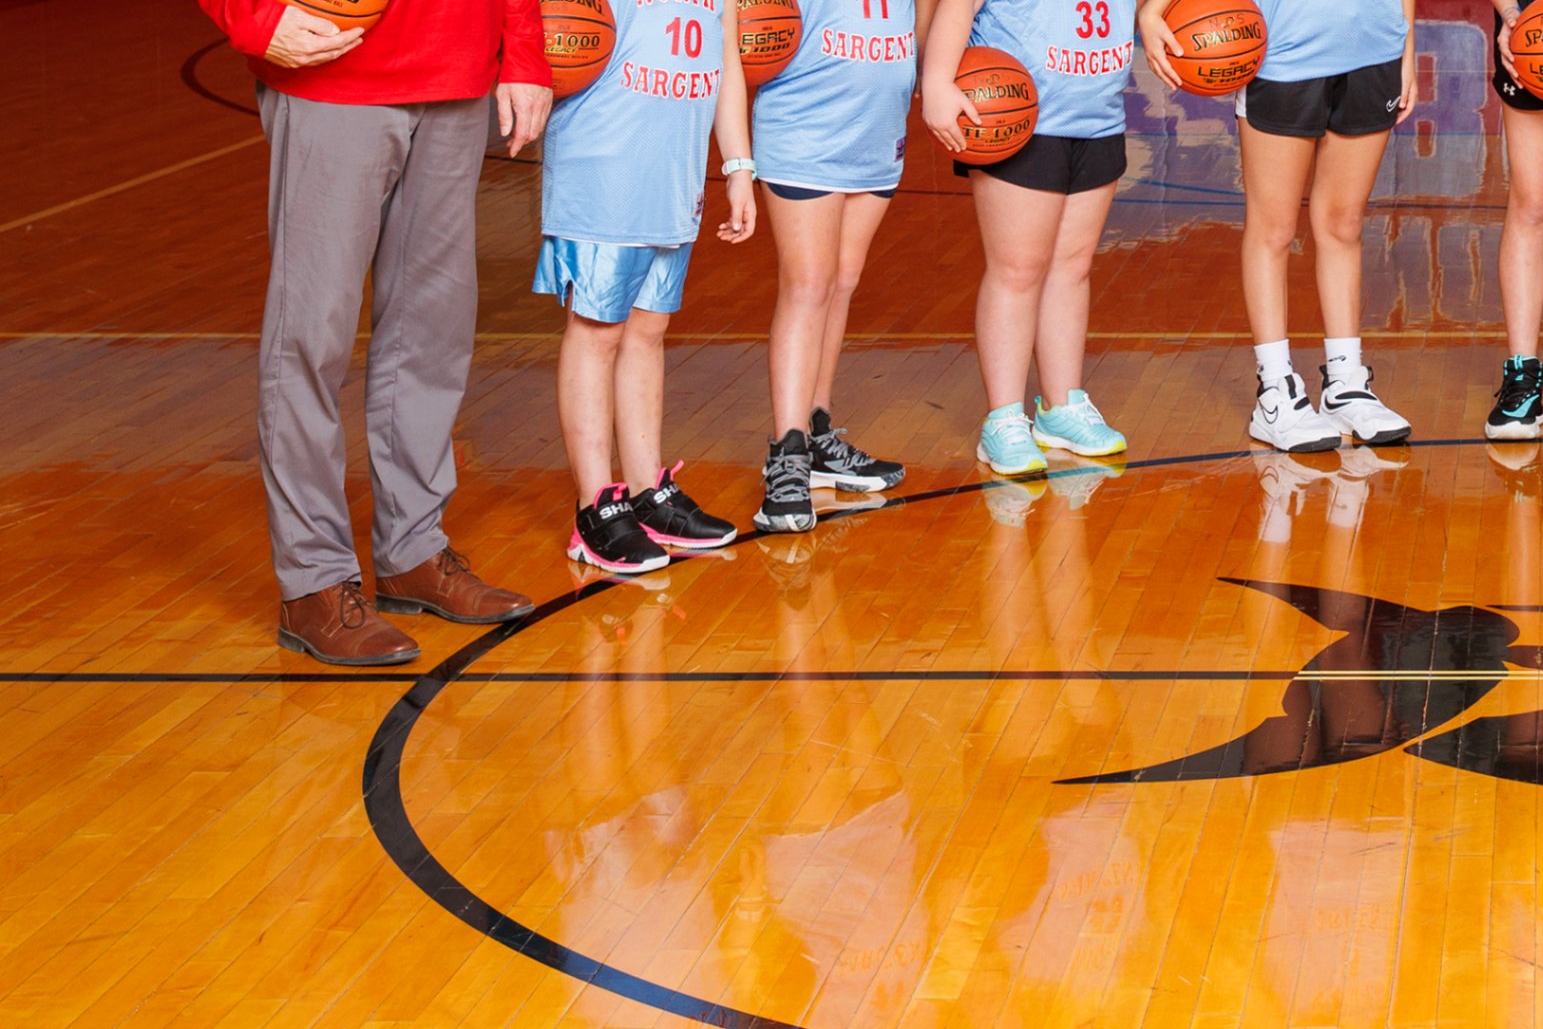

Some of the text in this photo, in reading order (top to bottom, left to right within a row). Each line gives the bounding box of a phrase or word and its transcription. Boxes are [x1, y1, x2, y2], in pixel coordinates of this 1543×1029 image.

[738, 28, 795, 45] EGACY
[1075, 0, 1111, 39] 33
[1192, 21, 1262, 52] SPALDING
[666, 17, 702, 58] 10
[821, 28, 914, 62] SARGENT
[1046, 40, 1134, 75] SARGENT
[1198, 55, 1260, 78] LEGACY
[620, 61, 720, 99] SARGENT
